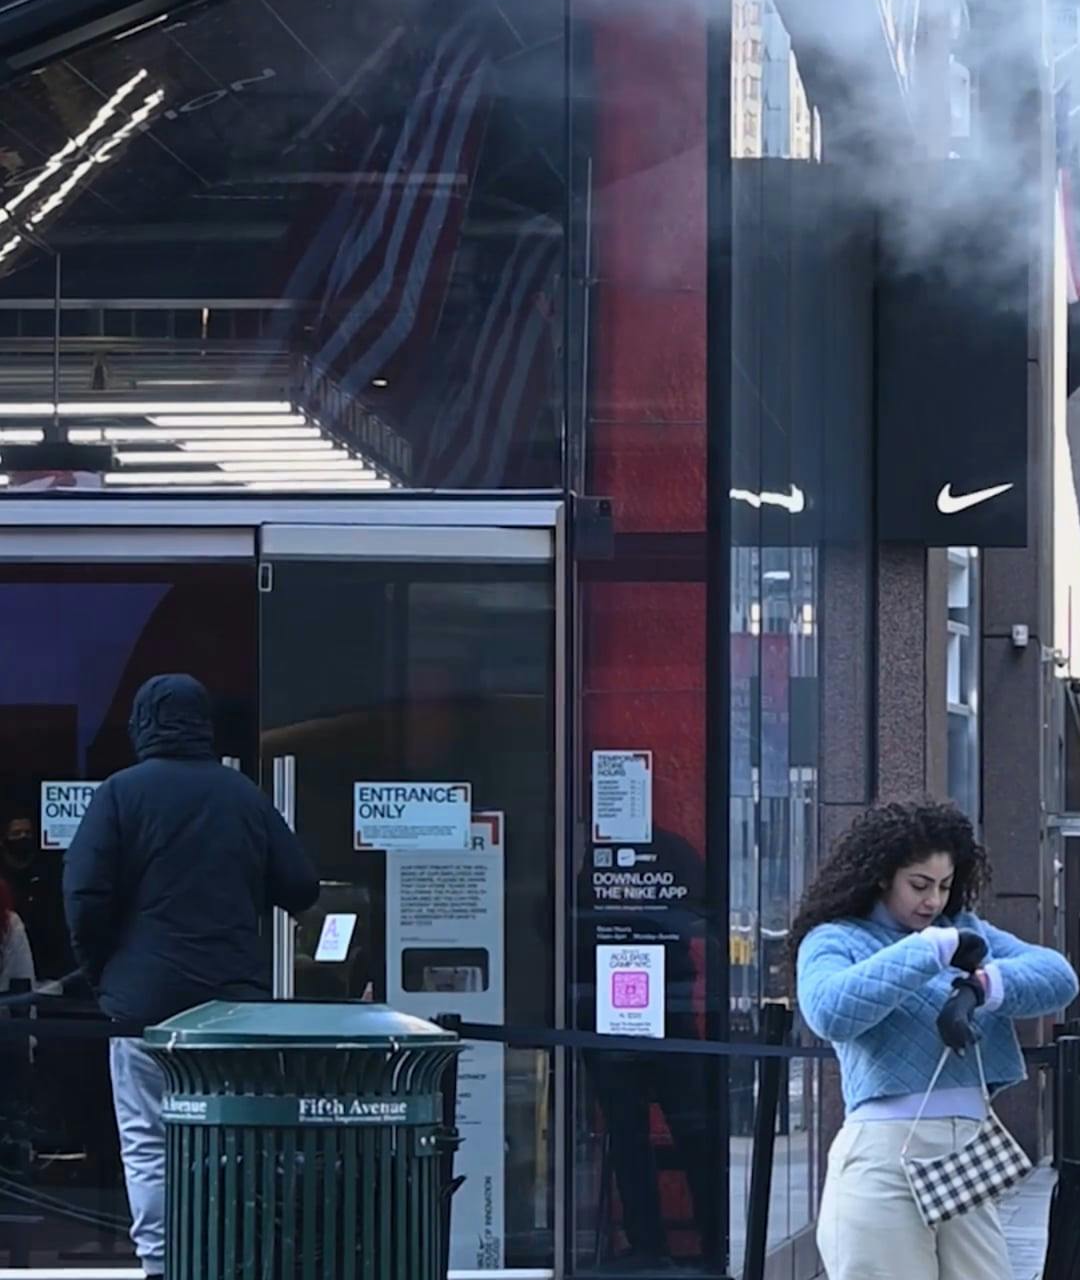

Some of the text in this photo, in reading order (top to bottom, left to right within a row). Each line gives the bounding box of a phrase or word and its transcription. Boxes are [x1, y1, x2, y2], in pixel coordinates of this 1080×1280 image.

[359, 787, 457, 802] ENTRANCE
[359, 805, 406, 819] ONLY
[593, 872, 674, 885] DOWNLOAD
[594, 887, 687, 898] THE NIKE APP
[299, 1099, 408, 1115] Fifth Avenue
